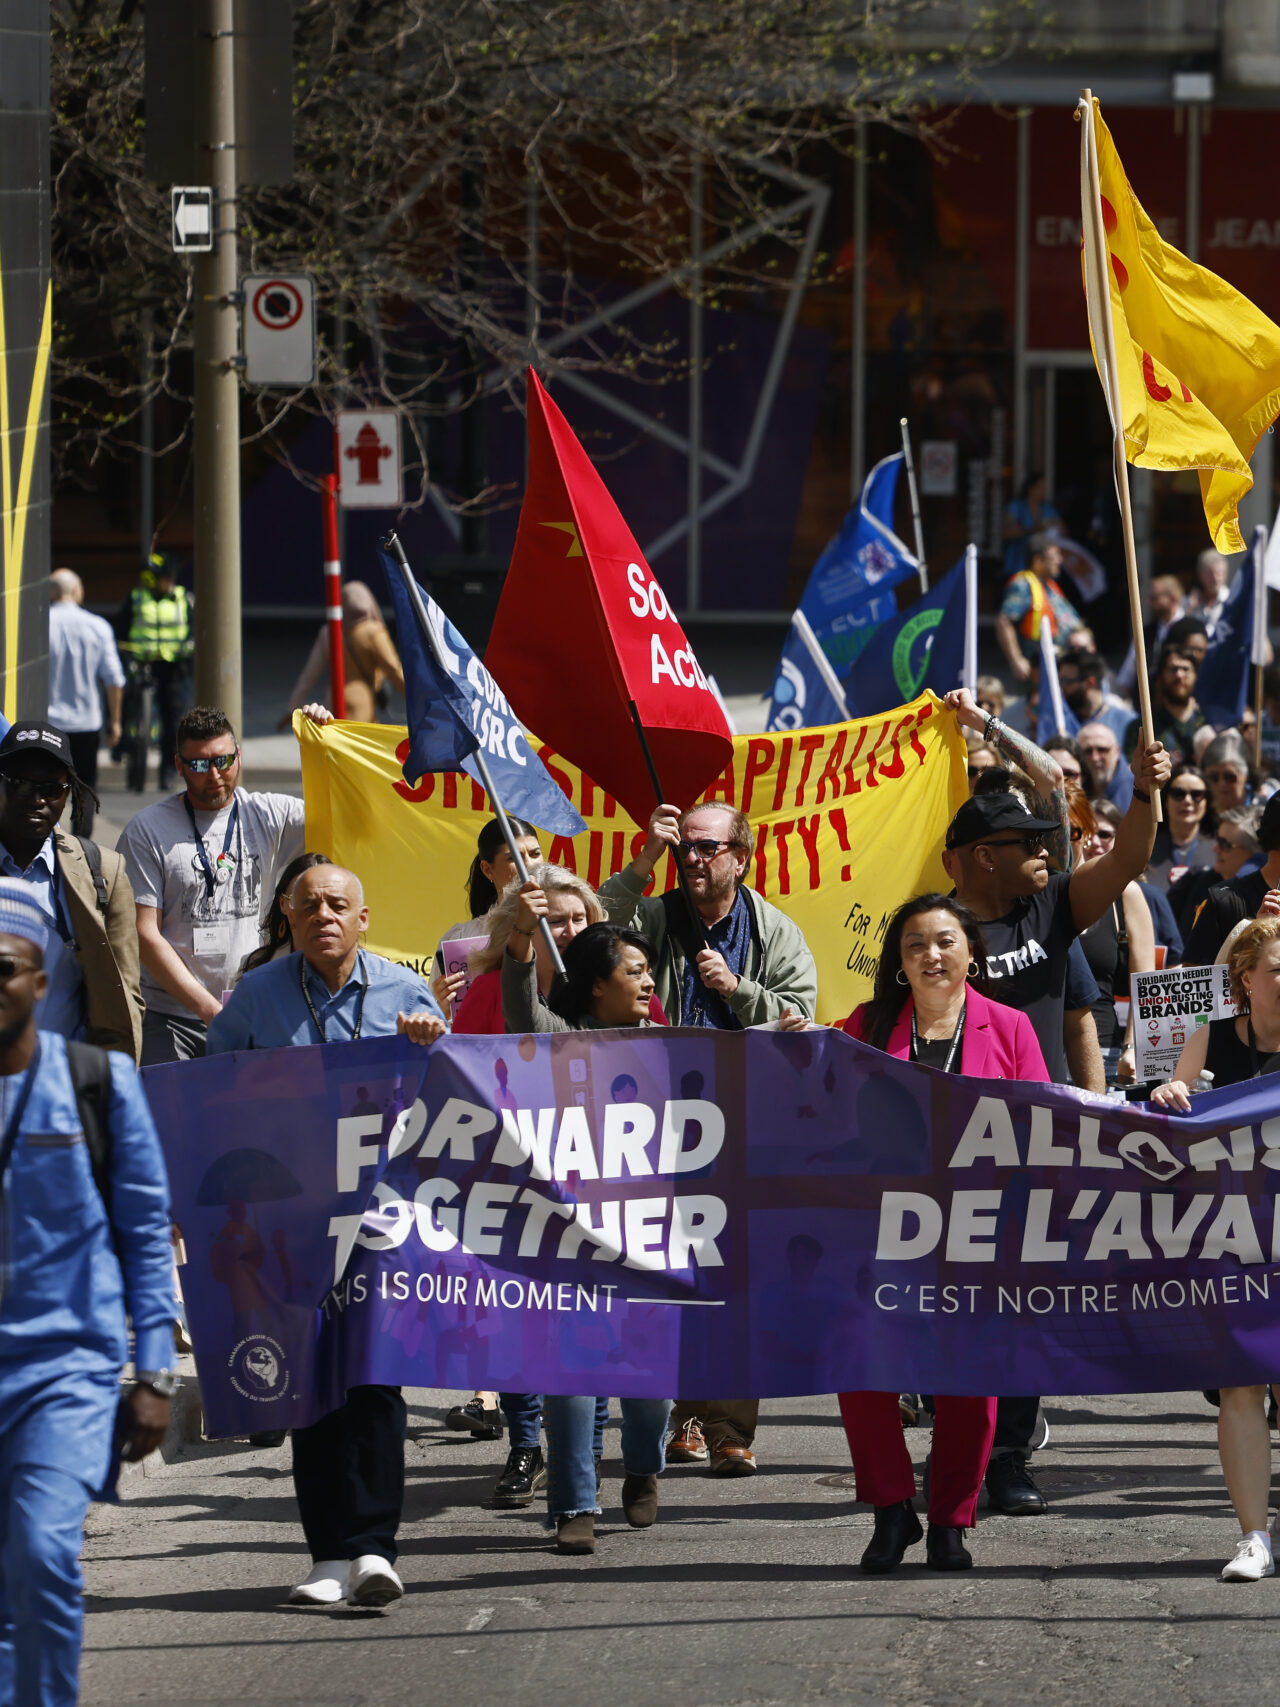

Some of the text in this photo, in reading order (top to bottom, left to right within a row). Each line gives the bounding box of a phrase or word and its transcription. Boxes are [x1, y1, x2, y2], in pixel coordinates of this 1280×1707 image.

[702, 702, 933, 814] APITALIST
[985, 938, 1049, 979] CTRA
[1137, 968, 1213, 986] SOLIDARITY NEEDED!
[1138, 979, 1213, 998] BOYCOTT
[1139, 999, 1213, 1020] BRANDS
[335, 1097, 727, 1194] FORWARD
[327, 1177, 728, 1287] TOGETHER
[875, 1188, 1003, 1264] DE
[381, 1270, 409, 1301] IS
[416, 1272, 468, 1307] OUR
[474, 1278, 620, 1314] MOMENT
[873, 1282, 981, 1316] C'EST
[998, 1282, 1119, 1316] NOTRE
